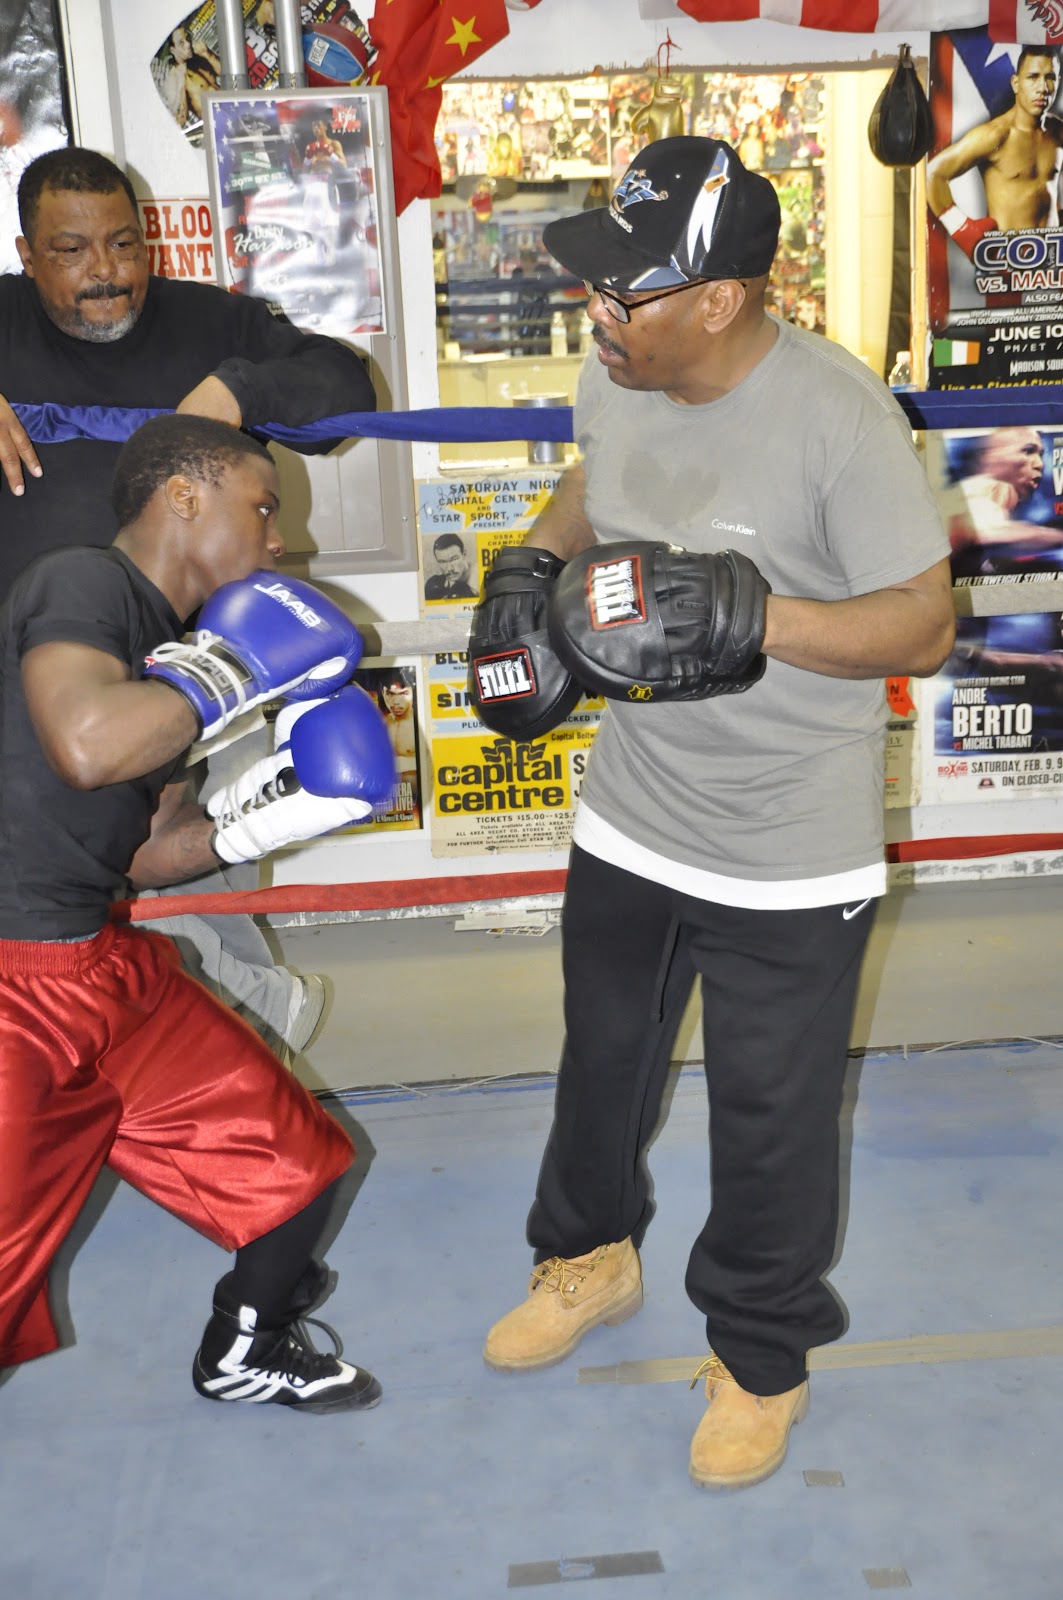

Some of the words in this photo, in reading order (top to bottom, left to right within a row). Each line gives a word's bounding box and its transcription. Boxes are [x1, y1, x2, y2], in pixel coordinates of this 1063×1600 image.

[976, 276, 1008, 294] VS.
[1025, 294, 1048, 304] ALSO
[1006, 315, 1034, 323] TOMMY
[988, 325, 1042, 342] JUNE
[986, 345, 995, 355] 9
[450, 481, 518, 494] SATURDAY
[438, 496, 485, 506] CAPITAL
[494, 493, 539, 504] CENTRE
[432, 514, 461, 523] STAR
[470, 511, 510, 521] SPORT,
[735, 523, 757, 536] Klein
[954, 574, 1023, 588] WELTERWEIGHT
[1023, 572, 1056, 583] STORM
[952, 687, 987, 705] ANDRE
[952, 703, 1033, 738] BERTO
[962, 736, 994, 751] MICHEL
[995, 734, 1033, 749] TRABANT
[437, 755, 563, 789] capital
[971, 761, 1022, 774] SATURDAY,
[1024, 759, 1043, 771] FEB.
[1002, 776, 1015, 787] ON
[439, 785, 565, 814] centre
[475, 815, 513, 824] TICKETS
